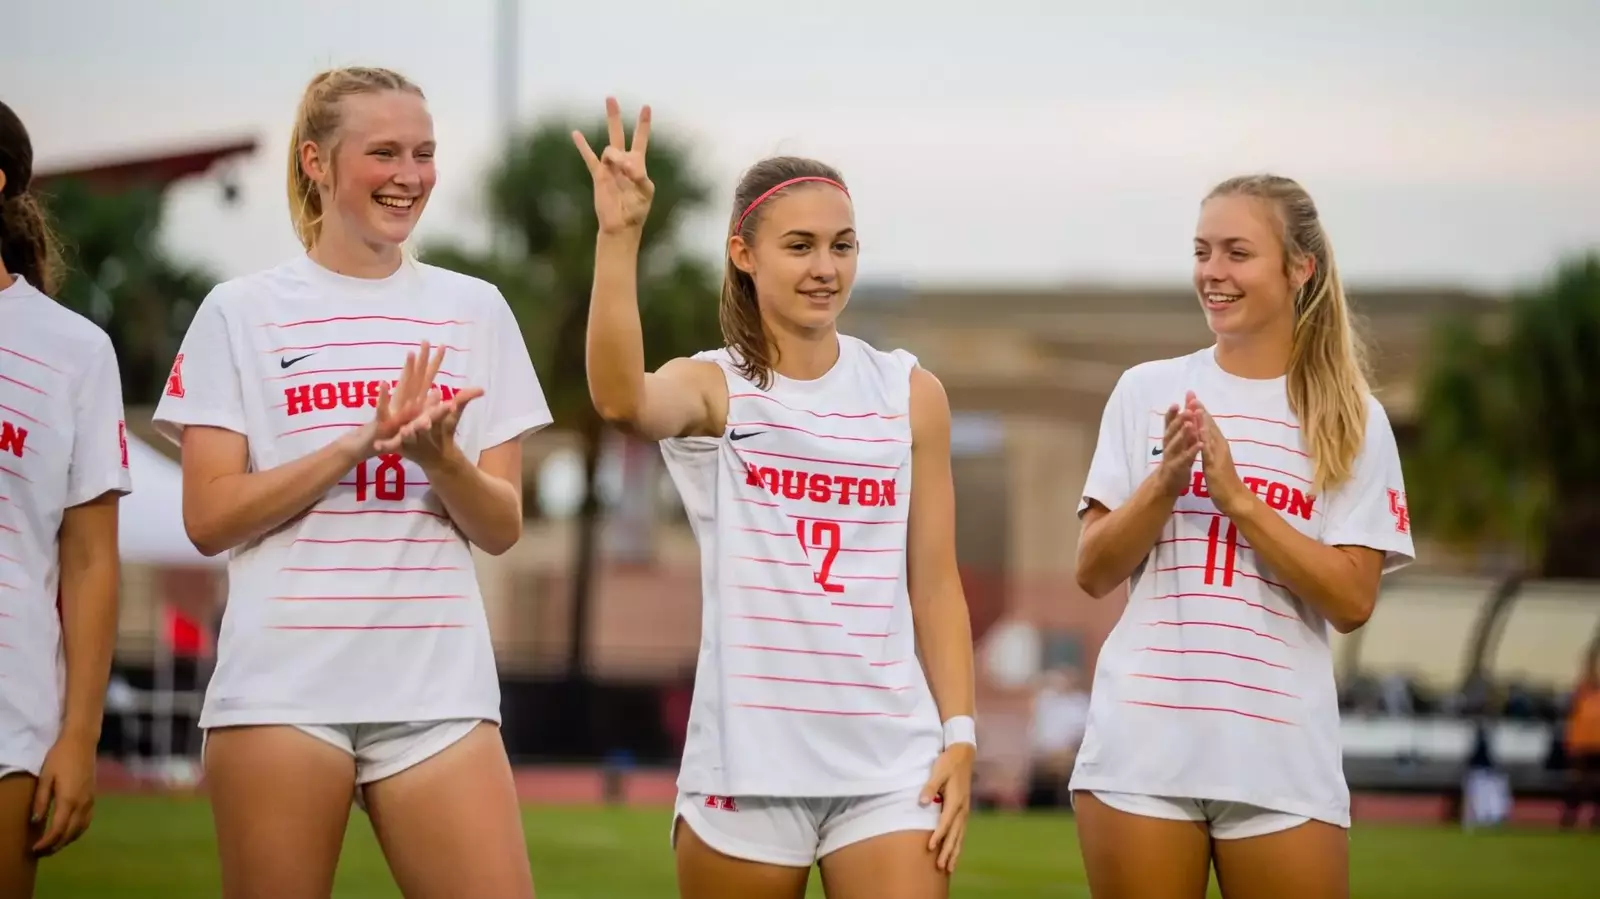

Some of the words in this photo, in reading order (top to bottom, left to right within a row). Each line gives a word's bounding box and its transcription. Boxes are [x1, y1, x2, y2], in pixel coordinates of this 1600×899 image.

[356, 453, 405, 501] 18
[796, 519, 845, 593] 12
[1203, 515, 1237, 587] 11
